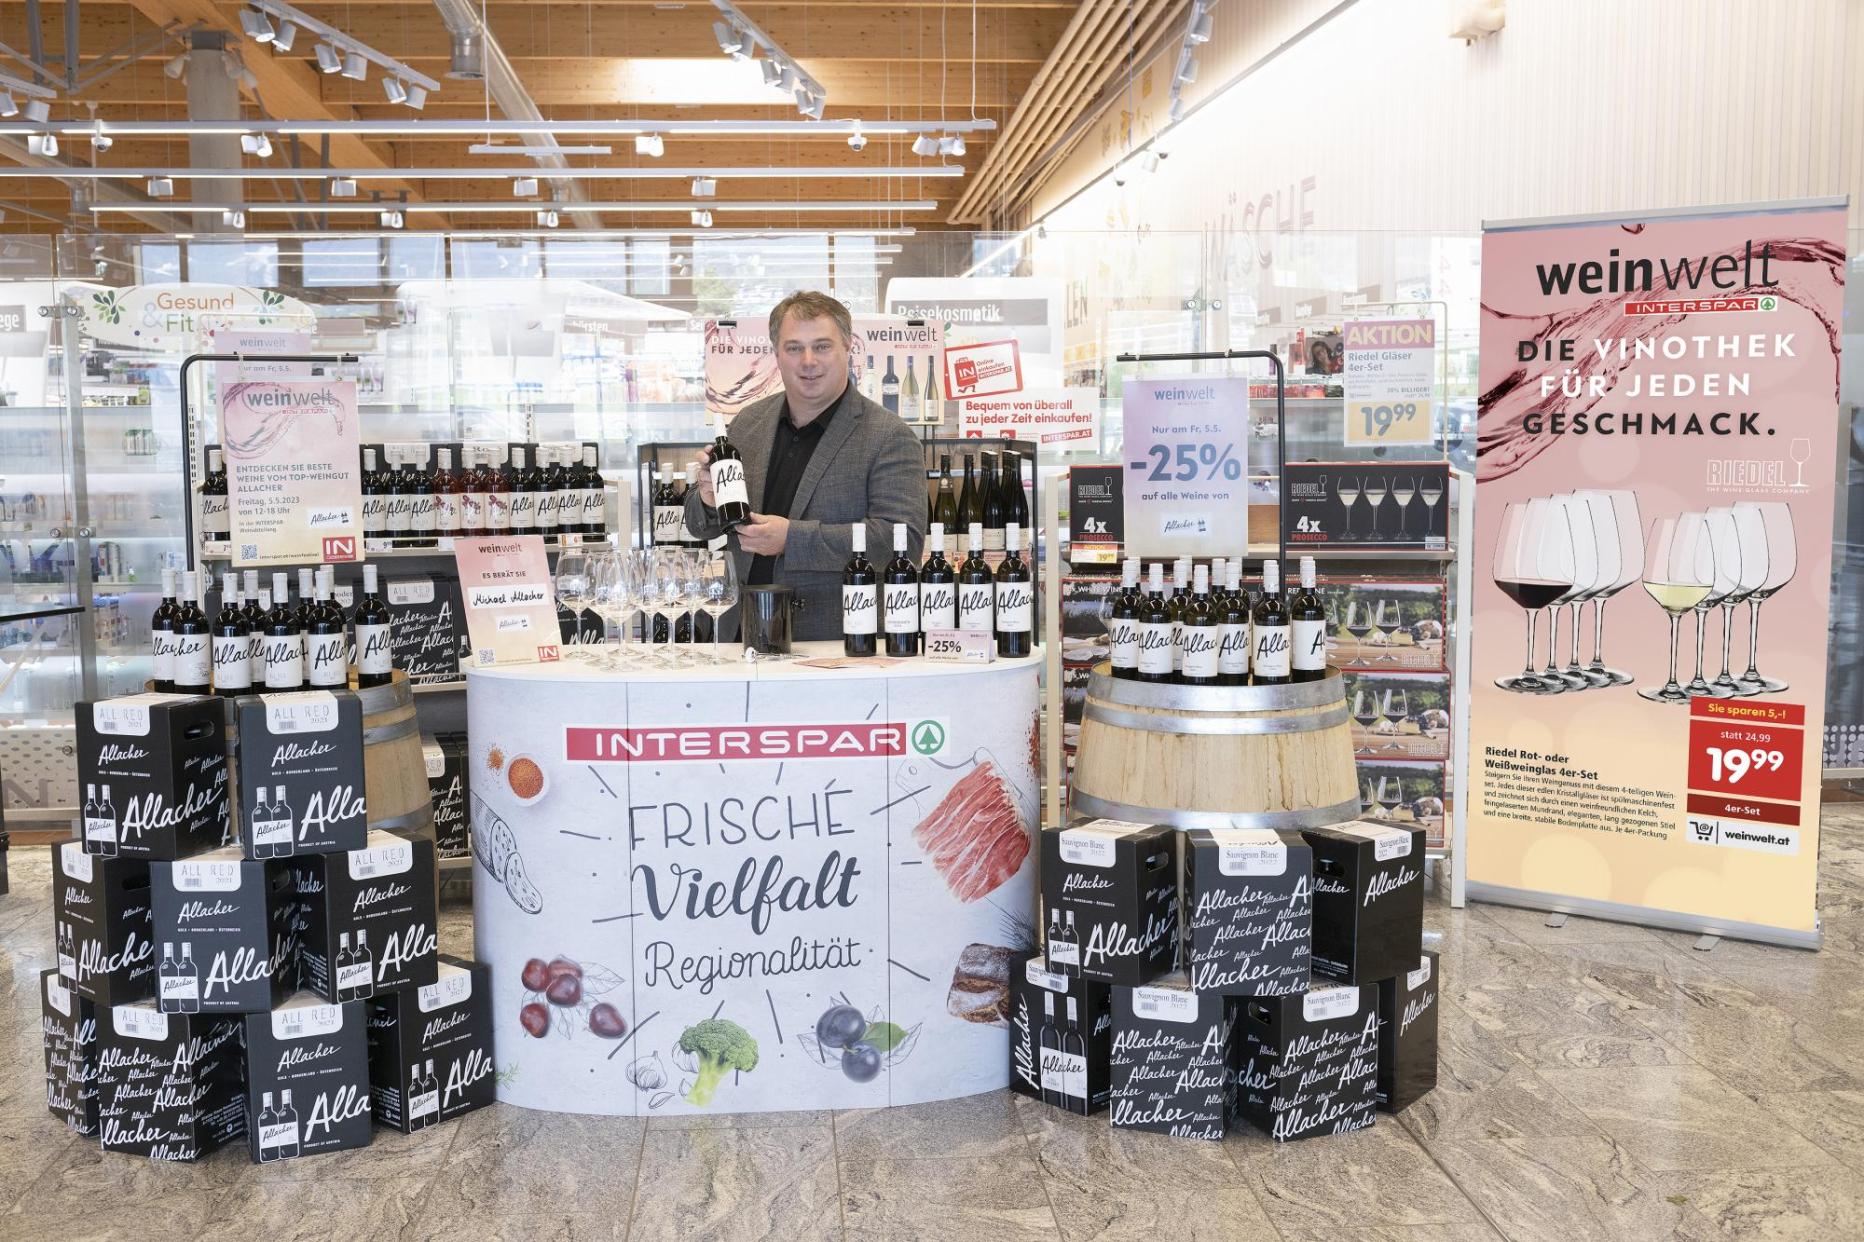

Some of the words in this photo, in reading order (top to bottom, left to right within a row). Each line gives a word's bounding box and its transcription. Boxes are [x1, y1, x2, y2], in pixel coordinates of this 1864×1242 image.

[1536, 239, 1779, 296] weinwelt
[157, 292, 235, 312] Gesund
[1636, 299, 1757, 313] INTERSPAR
[166, 313, 194, 333] Fit
[712, 336, 731, 345] DIE
[867, 326, 938, 342] weinwelt
[1346, 324, 1432, 346] AKTION
[712, 344, 734, 354] FÜR
[1348, 351, 1379, 361] Riedel
[1381, 351, 1413, 360] Gläser
[1517, 339, 1575, 362] DIE
[1593, 333, 1796, 361] VINOTHEK
[958, 366, 975, 378] IN
[1348, 362, 1384, 372] 4er-Set
[1154, 386, 1216, 400] weinwelt
[1540, 369, 1606, 398] FÜR
[1625, 373, 1751, 397] JEDEN
[247, 388, 335, 407] weinwelt
[966, 400, 1010, 414] Bequem
[1034, 400, 1073, 410] überall
[966, 415, 979, 423] zu
[981, 413, 1008, 426] jeder
[1012, 413, 1033, 423] Zeit
[1034, 412, 1092, 423] einkaufen!
[1523, 412, 1776, 436] GESCHMACK.
[1043, 430, 1091, 442] INTERSPAR.AT
[1152, 426, 1169, 434] Nur
[1204, 425, 1222, 433] 5.5.
[236, 464, 289, 473] ENTDECKEN
[291, 463, 304, 471] SIE
[1130, 443, 1241, 482] -25%
[236, 474, 265, 482] WEINE
[289, 473, 350, 481] TOP-WEINGUT
[1706, 460, 1786, 486] RIEDEL
[237, 484, 283, 493] ALLACHER
[1141, 491, 1159, 501] auf
[1160, 491, 1178, 500] alle
[1180, 492, 1209, 500] Weine
[1212, 492, 1230, 500] von
[268, 496, 300, 504] 5.5.2023
[255, 507, 276, 515] 12-18
[1083, 517, 1107, 533] 4x
[325, 539, 353, 555] IN
[478, 543, 522, 554] weinwelt
[493, 570, 514, 578] BERÄT
[928, 640, 962, 653] -25%
[274, 706, 296, 720] ALL
[305, 705, 330, 718] RED
[1708, 703, 1725, 713] Sie
[1727, 706, 1766, 717] sparen
[595, 729, 902, 758] INTERSPAR
[1720, 730, 1742, 741] statt
[1745, 732, 1771, 743] 24,99
[98, 743, 150, 766] Allacher
[271, 740, 337, 767] Allacher
[1485, 746, 1517, 758] Riedel
[1520, 750, 1542, 760] Rot-
[1544, 753, 1570, 763] oder
[1485, 758, 1557, 775] Weißweinglas
[1559, 767, 1599, 780] 4er-Set
[1582, 782, 1594, 790] mit
[121, 782, 224, 843] Allacher
[298, 785, 367, 841] Alla
[1724, 803, 1761, 816] 4er-Set
[1725, 830, 1790, 846] weinwelt.at
[1260, 850, 1279, 859] Blanc
[631, 849, 861, 936] Vielfalt
[1062, 873, 1114, 893] Allacher
[1363, 865, 1420, 907] Allacher
[353, 882, 412, 913] Allacher
[1195, 885, 1271, 918] Allacher
[177, 900, 240, 924] Allacher
[1083, 913, 1175, 967] Allacher
[377, 923, 438, 982] Alla
[645, 936, 861, 995] Regionalität
[1400, 992, 1436, 1037] Allacher
[422, 1011, 470, 1045] Allacher
[1014, 992, 1040, 1090] Allacher
[1112, 1029, 1184, 1055] Allacher
[1284, 1028, 1347, 1067] Allacher
[99, 1046, 158, 1073] Allacher
[277, 1042, 342, 1073] Allacher
[1042, 1055, 1085, 1075] Allacher
[304, 1084, 372, 1142] Alla
[1272, 1100, 1355, 1143] Allacher
